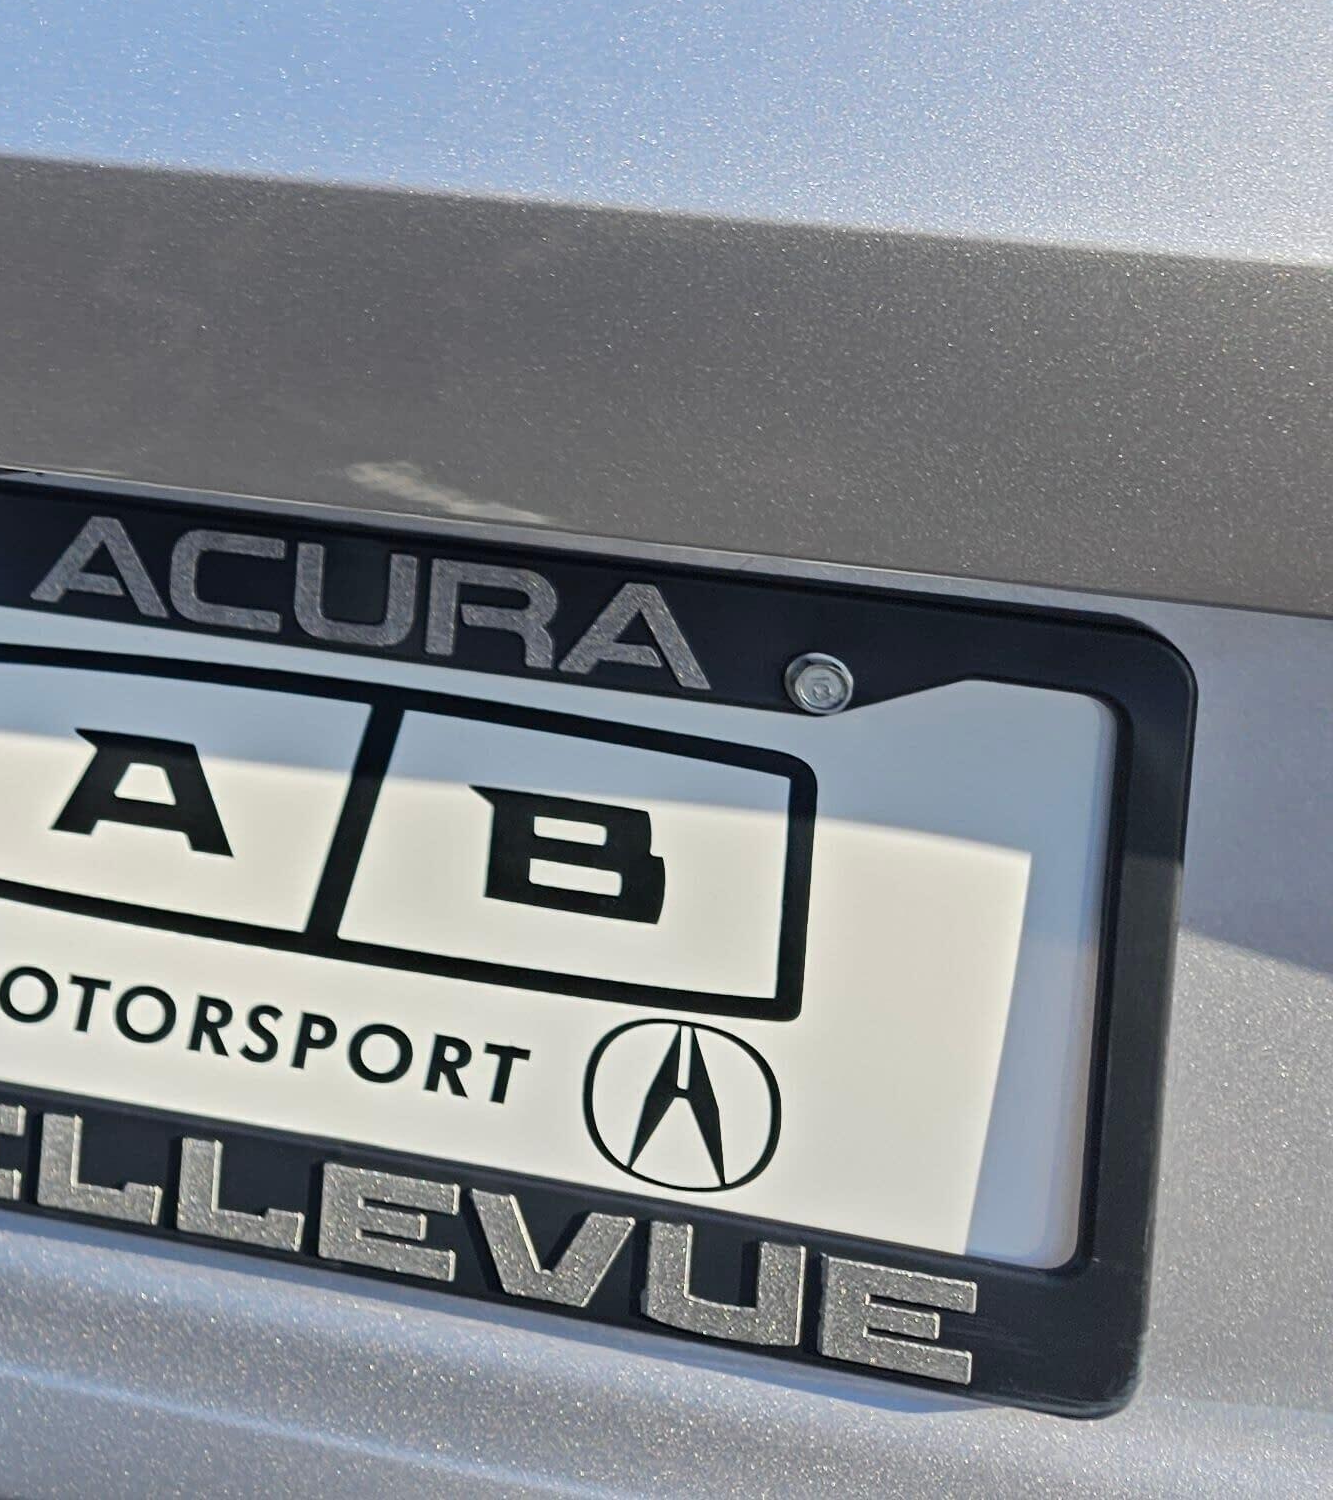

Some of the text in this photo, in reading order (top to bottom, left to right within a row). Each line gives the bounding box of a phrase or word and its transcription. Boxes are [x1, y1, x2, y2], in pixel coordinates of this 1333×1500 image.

[31, 516, 711, 690] ACURA
[50, 728, 666, 924] A B
